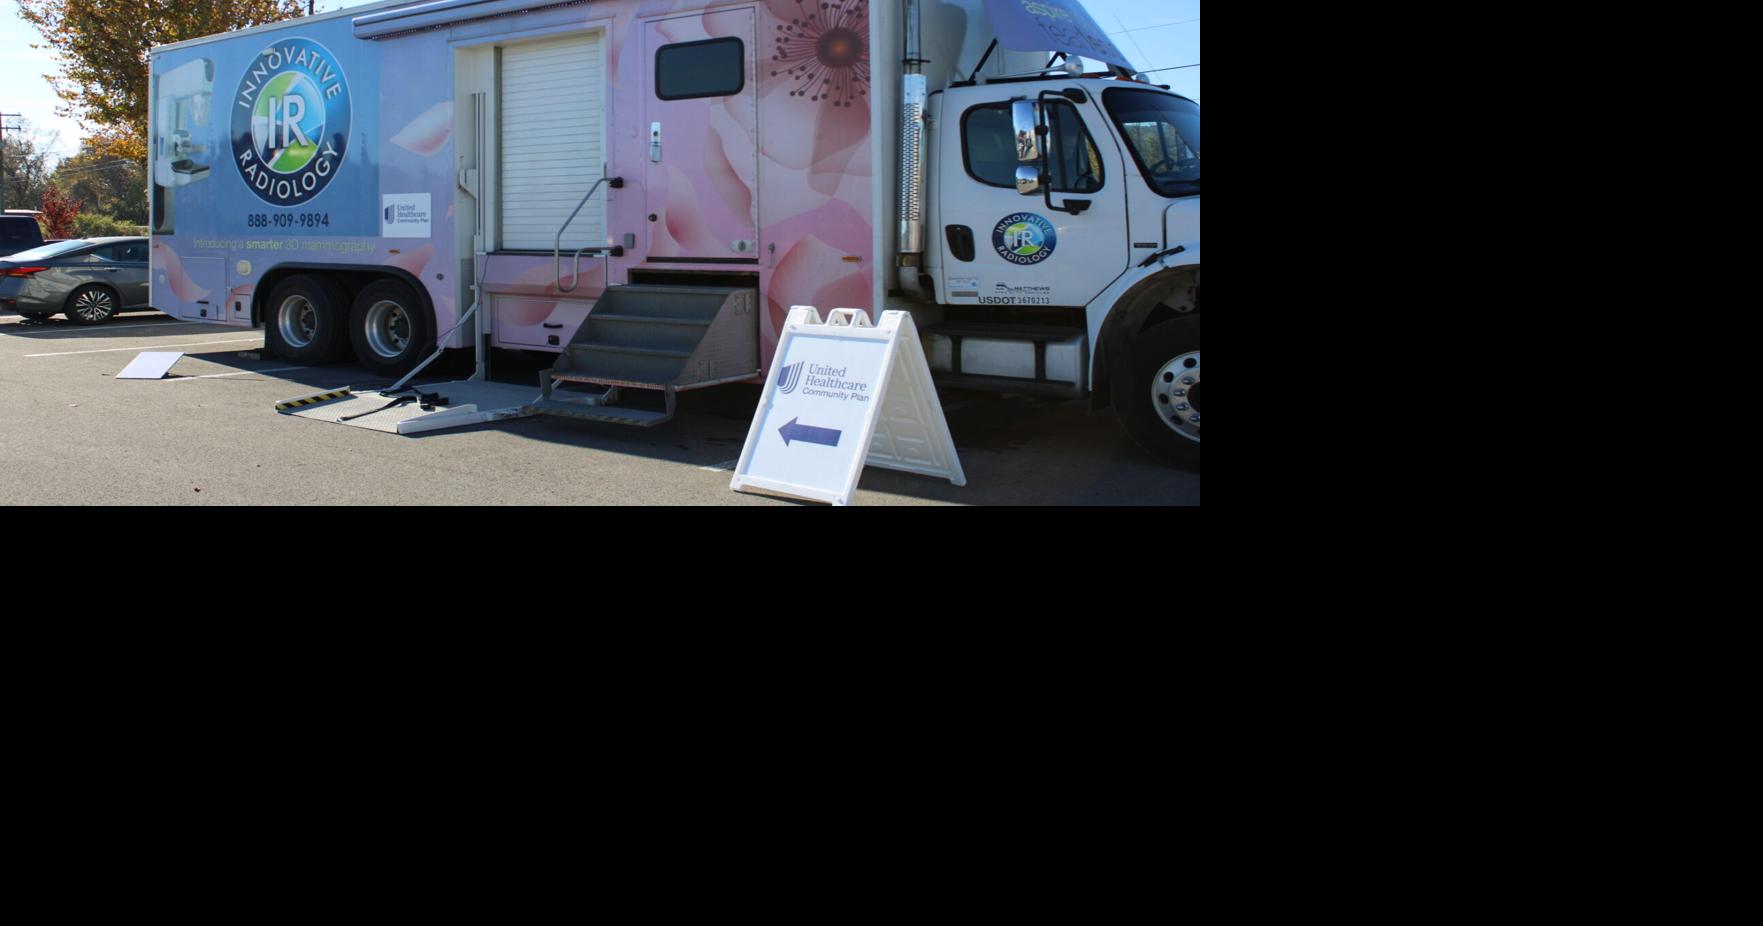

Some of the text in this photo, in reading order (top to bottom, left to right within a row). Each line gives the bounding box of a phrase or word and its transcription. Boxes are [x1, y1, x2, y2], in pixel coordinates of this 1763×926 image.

[239, 46, 342, 108] INNOVATIVE
[268, 94, 309, 149] IR
[239, 142, 339, 199] RADIOLOGY
[247, 213, 330, 228] 888-909-9894
[996, 214, 1052, 234] INNOVATIVE
[246, 240, 283, 250] smarter
[1013, 231, 1033, 247] IR
[997, 245, 1051, 264] RADIOLOGY
[978, 296, 1016, 304] USDOT
[809, 364, 847, 377] United
[805, 375, 867, 392] Healthcare
[802, 387, 870, 402] Community Plan
